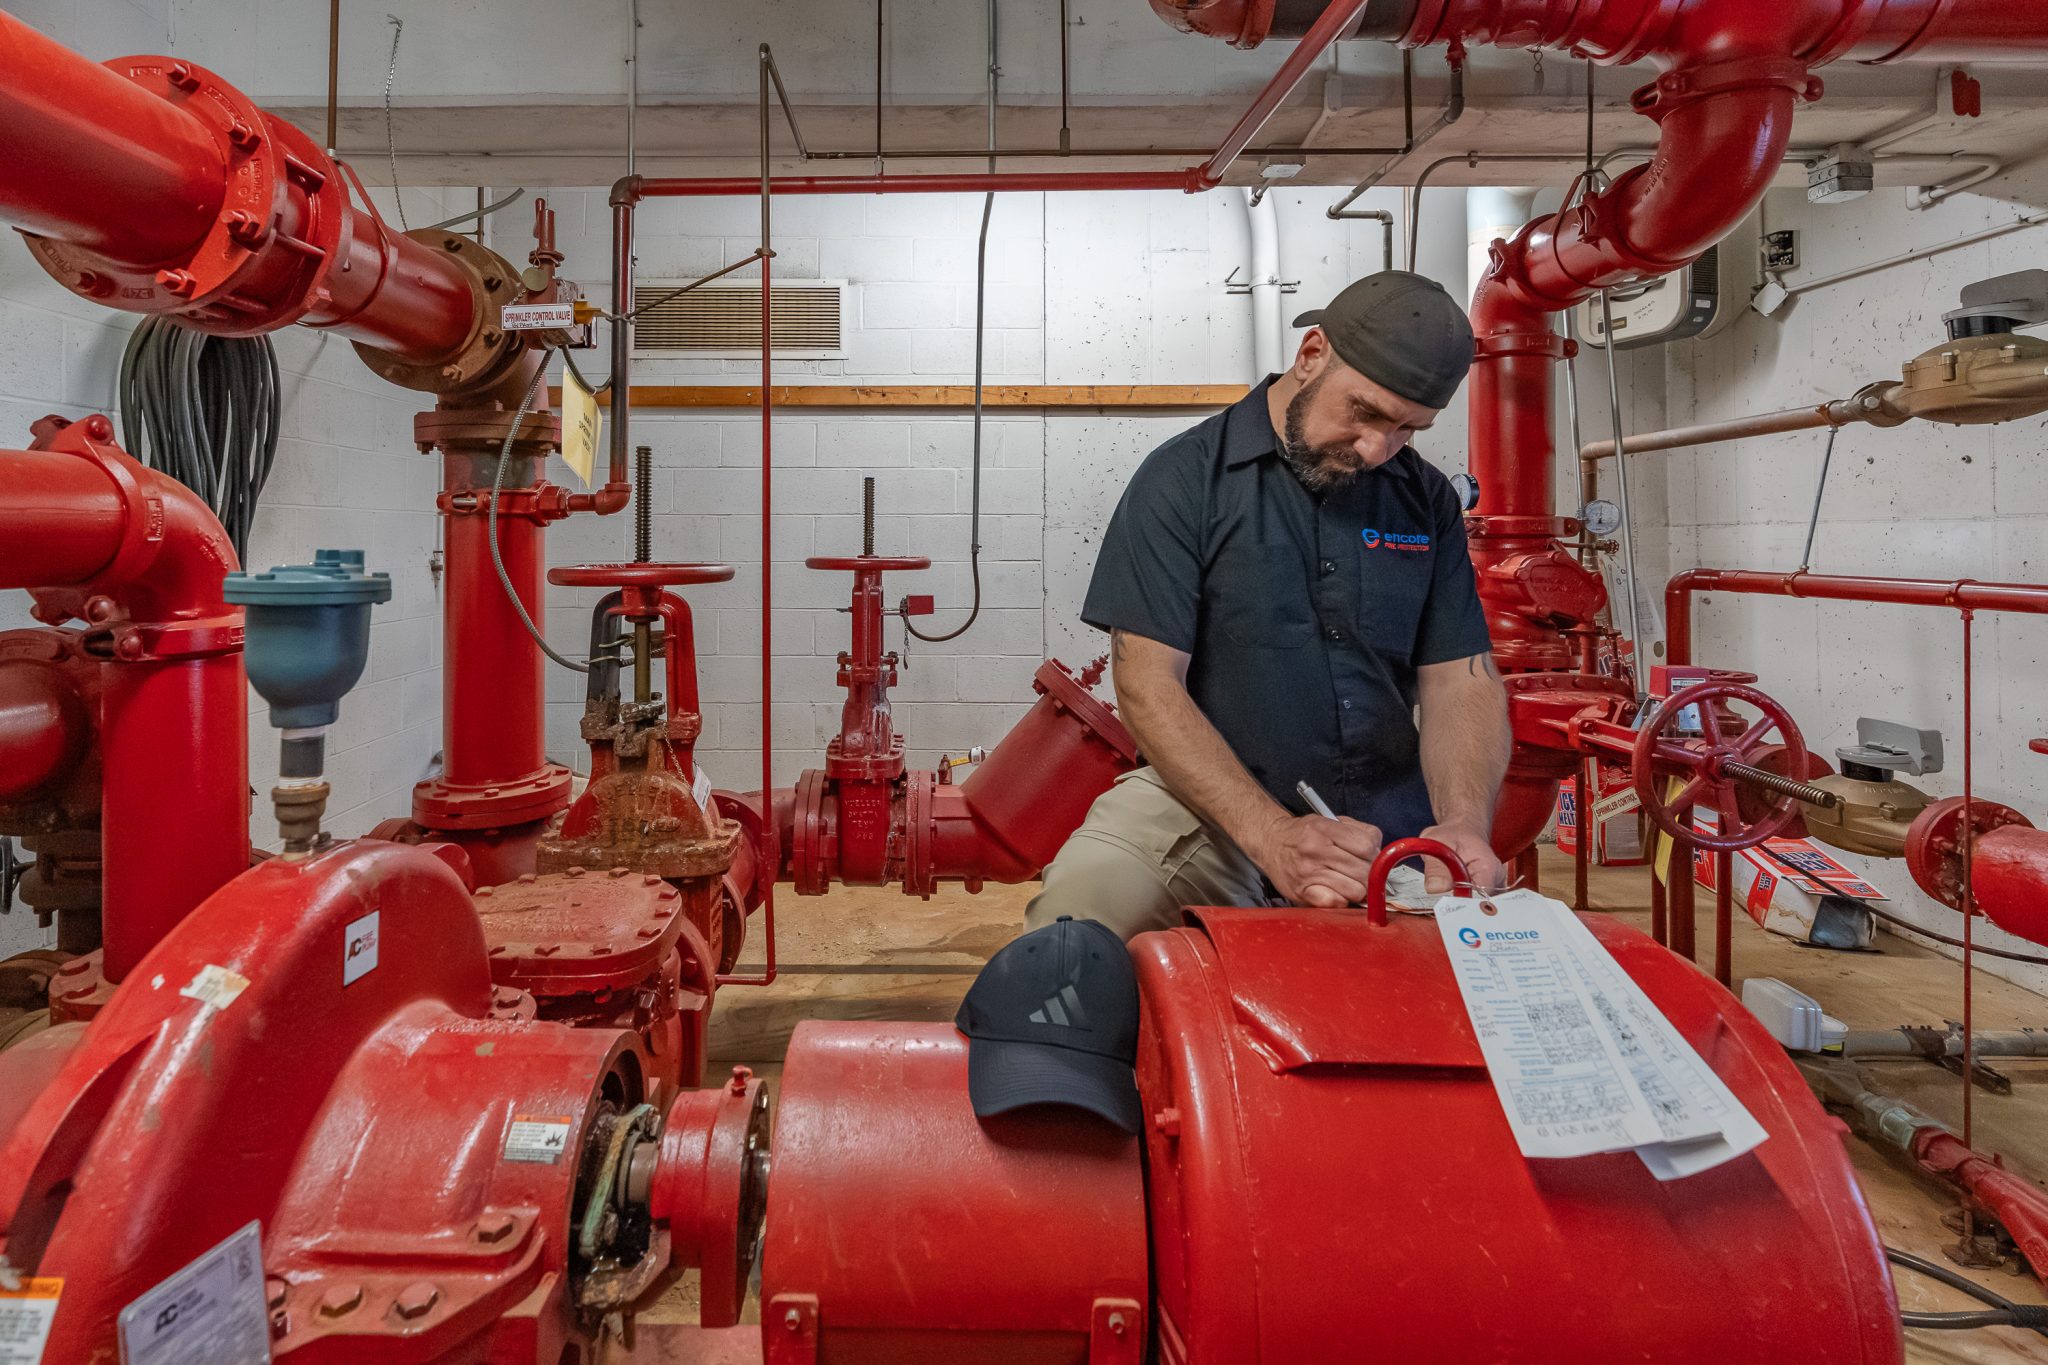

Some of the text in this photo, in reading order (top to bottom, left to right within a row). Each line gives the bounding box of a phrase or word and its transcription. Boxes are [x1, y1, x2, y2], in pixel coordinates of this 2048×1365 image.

[505, 310, 571, 322] SPRINKLER CONTROL VALVE
[1384, 533, 1430, 544] encore
[1560, 792, 1576, 811] ICE
[1595, 793, 1638, 818] SPRINKLER CONTROL
[1763, 875, 1773, 891] ICE
[1485, 929, 1540, 942] encore
[347, 937, 362, 961] AC
[154, 1303, 178, 1334] AC
